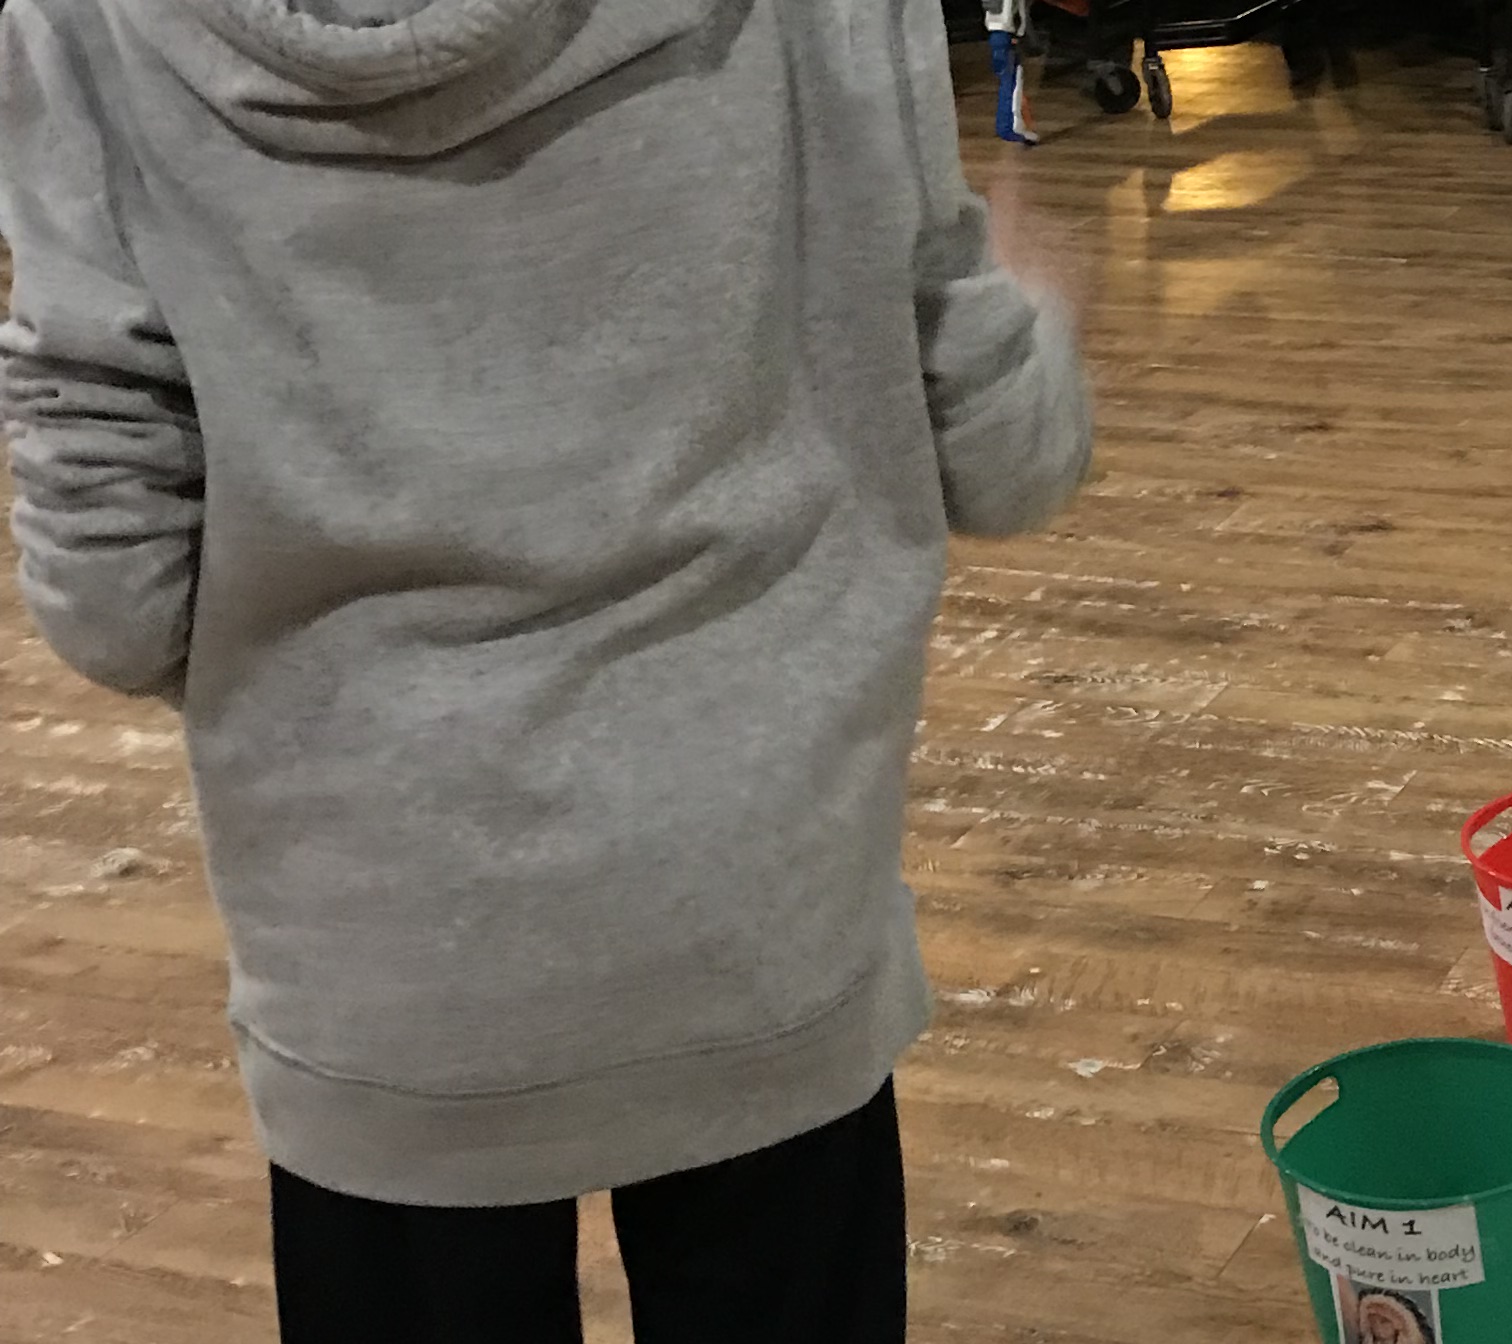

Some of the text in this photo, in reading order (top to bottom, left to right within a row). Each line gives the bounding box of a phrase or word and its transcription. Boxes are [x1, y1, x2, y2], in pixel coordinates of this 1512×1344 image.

[1325, 1205, 1422, 1235] AIM 1
[1323, 1228, 1340, 1247] be
[1343, 1240, 1393, 1260] clean
[1396, 1246, 1422, 1261] in
[1426, 1243, 1476, 1263] body
[1346, 1264, 1385, 1283] pure
[1390, 1269, 1413, 1284] in
[1419, 1268, 1470, 1285] heart
